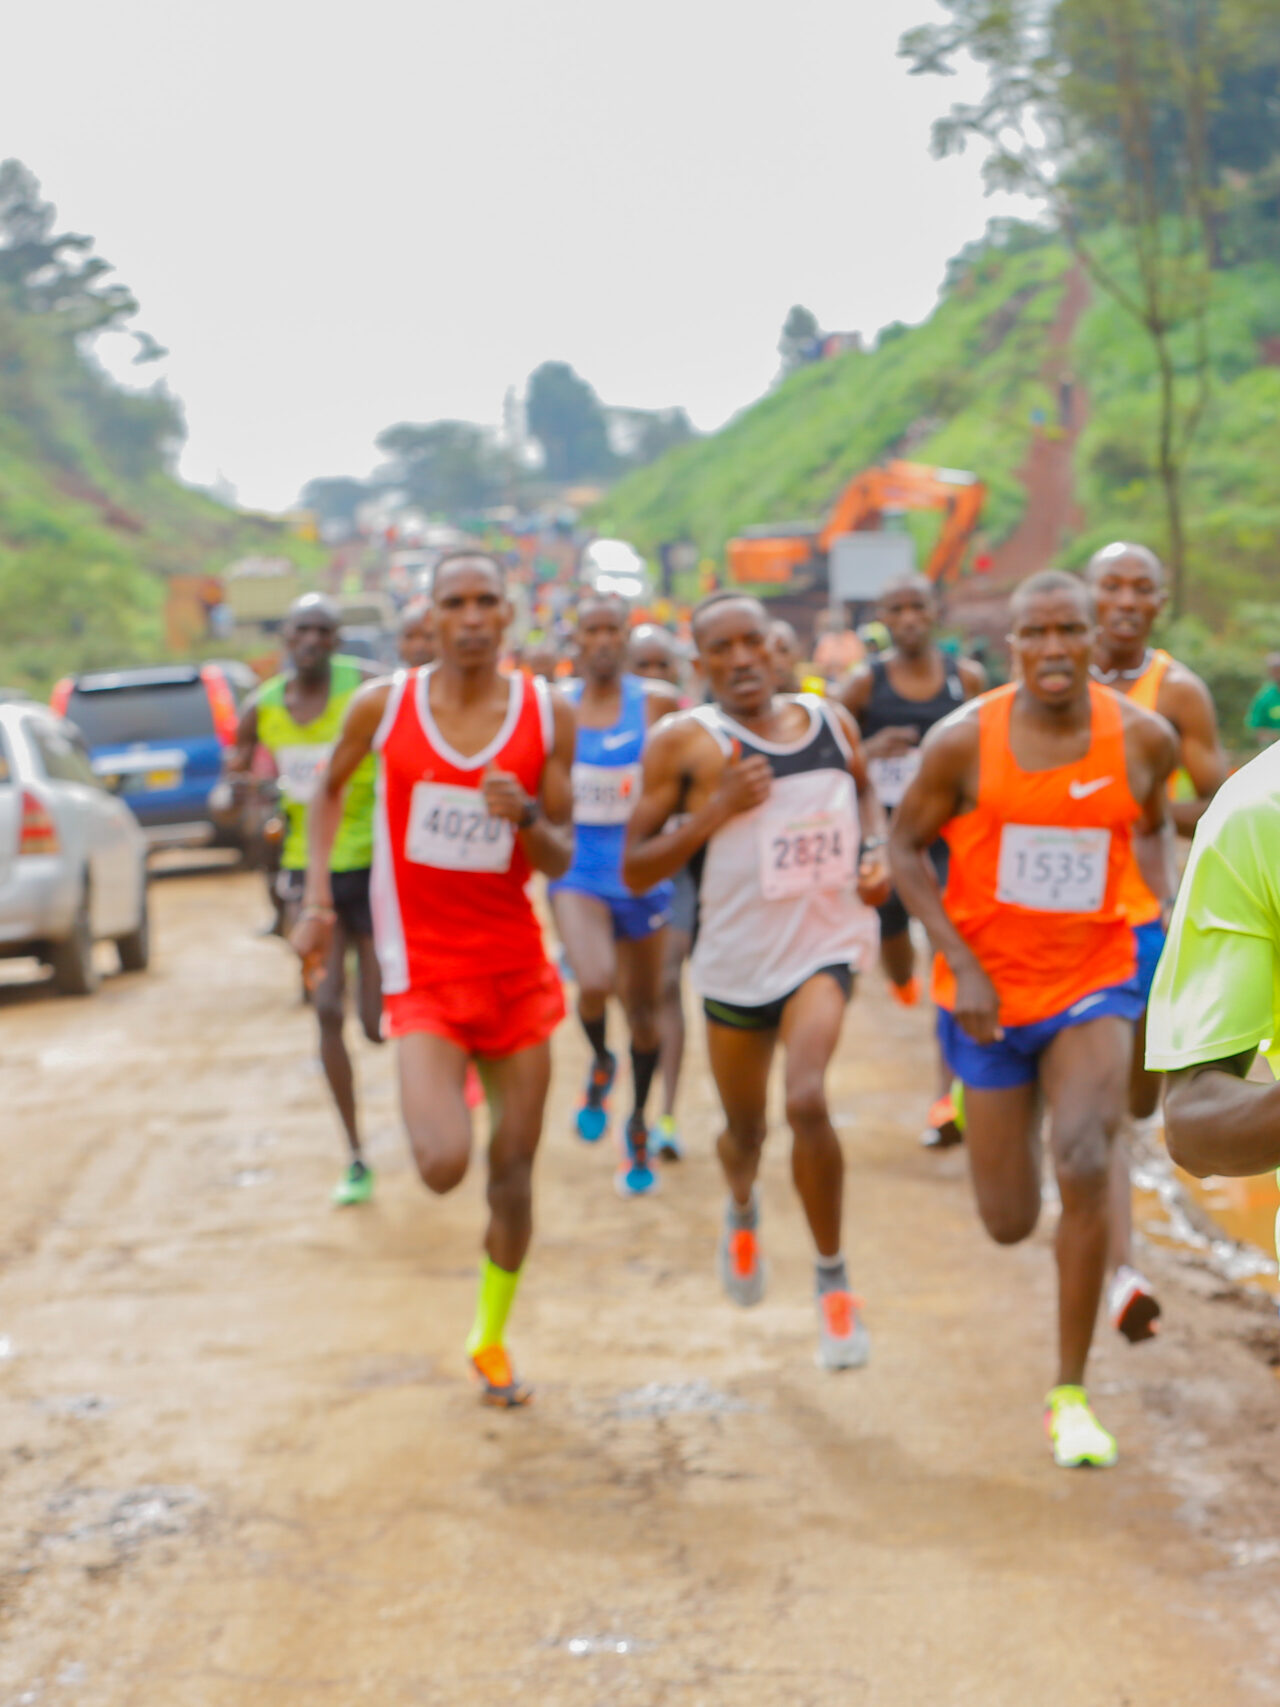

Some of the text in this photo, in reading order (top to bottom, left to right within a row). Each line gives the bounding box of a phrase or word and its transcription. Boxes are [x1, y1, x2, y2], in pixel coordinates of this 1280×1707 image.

[423, 805, 501, 844] 4020
[773, 829, 842, 868] 2824
[1016, 850, 1094, 884] 1535
